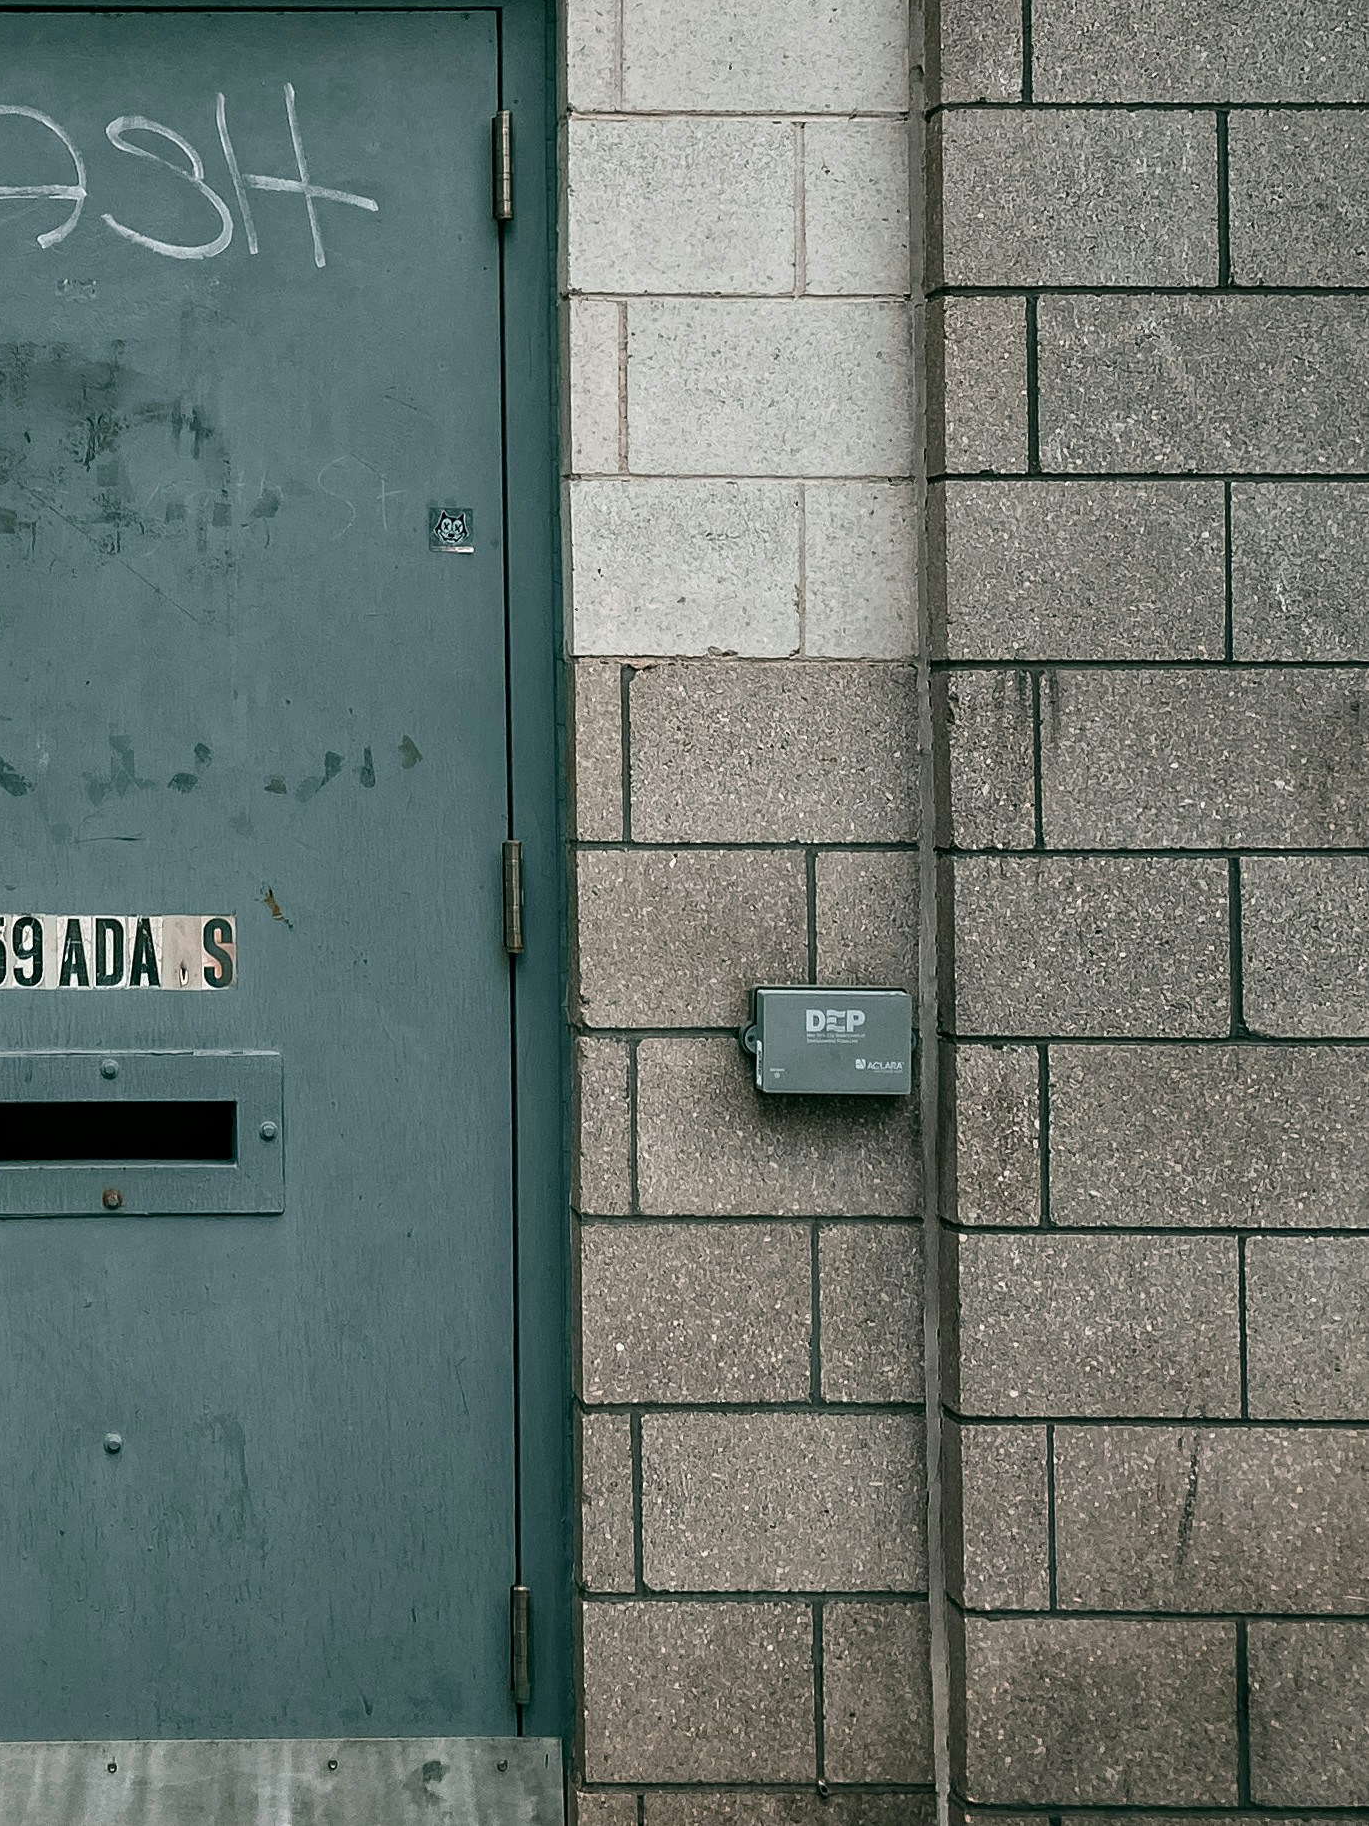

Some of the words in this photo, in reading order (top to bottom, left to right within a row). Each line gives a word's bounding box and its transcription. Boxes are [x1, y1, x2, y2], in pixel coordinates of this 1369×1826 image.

[58, 917, 234, 989] ADAS
[805, 1009, 866, 1033] DEP
[867, 1061, 903, 1070] ACLARA
